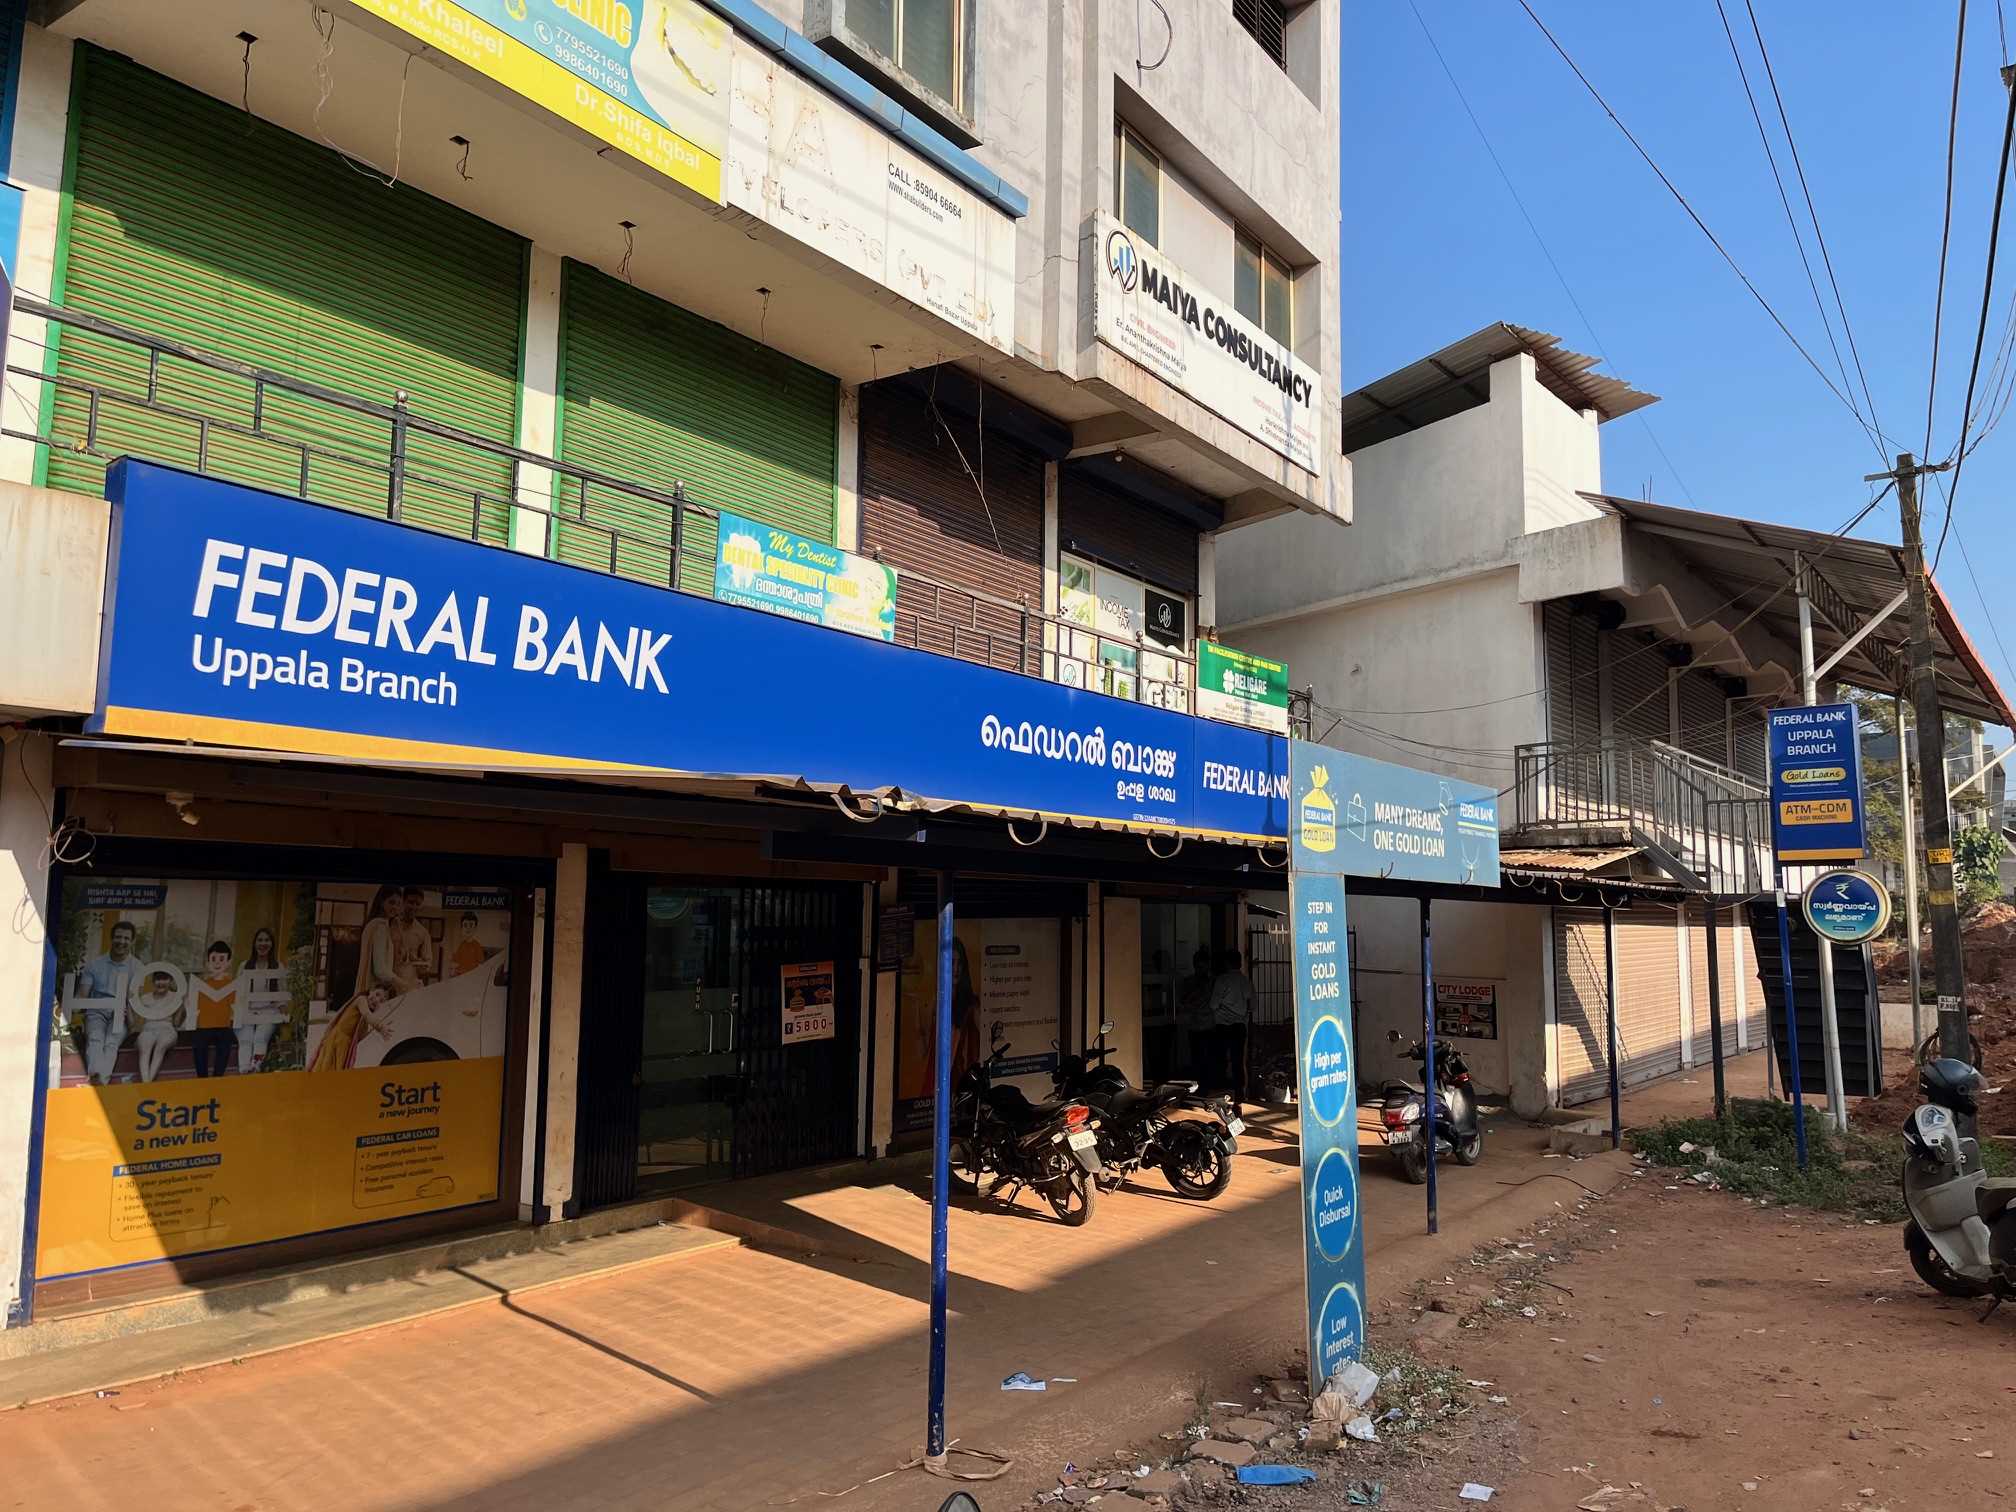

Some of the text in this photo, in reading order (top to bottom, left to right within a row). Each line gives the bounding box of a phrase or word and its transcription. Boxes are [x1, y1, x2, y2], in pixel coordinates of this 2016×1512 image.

[555, 26, 629, 80] 7795521690
[554, 45, 628, 97] 9986401690
[888, 162, 912, 187] CALL
[939, 195, 962, 220] 66664
[1141, 258, 1312, 408] MAIYA CONSULTANCY
[769, 530, 838, 568] My Dentist
[192, 538, 673, 694] FEDERAL BANK
[192, 633, 458, 706] Uppala Branch
[1235, 672, 1268, 696] RELIGARE
[1773, 711, 1846, 726] FEDERAL BANK
[981, 714, 1176, 779] ഫെഡറൽ ബാങ്ക്
[1787, 729, 1834, 742] UPPALA
[1787, 743, 1836, 756] BRANCH
[1203, 761, 1290, 801] FEDERAL BANK
[1786, 769, 1842, 781] Gold Loans
[1117, 780, 1176, 803] ഉപ്പള ശാഖ
[1374, 802, 1403, 826] MANY
[1405, 807, 1444, 835] DREAMS,
[1459, 802, 1479, 820] FEDERAL
[1303, 828, 1334, 844] GOLD LOAN
[1373, 829, 1445, 858] ONE GOLD LOAN
[445, 895, 505, 907] FEDERAL BANK
[1307, 901, 1333, 914] STEP IN
[1313, 922, 1329, 935] FOR
[1307, 941, 1336, 955] INSTANT
[1311, 962, 1336, 980] GOLD
[1310, 981, 1340, 1001] LOANS
[1438, 984, 1491, 996] CITY LODGE
[1314, 1051, 1342, 1071] High per
[1311, 1068, 1348, 1093] gram rates
[380, 1081, 441, 1108] Start
[135, 1098, 221, 1131] Start
[379, 1105, 441, 1119] a new journey
[134, 1126, 218, 1151] a new life
[361, 1134, 395, 1145] FEDERAL
[413, 1129, 438, 1138] LOANS
[119, 1155, 219, 1175] FEDERAL HOME LOANS
[1323, 1185, 1344, 1206] Quick
[1319, 1201, 1352, 1228] Disbursal
[1331, 1316, 1347, 1335] Low
[1326, 1330, 1354, 1359] interest
